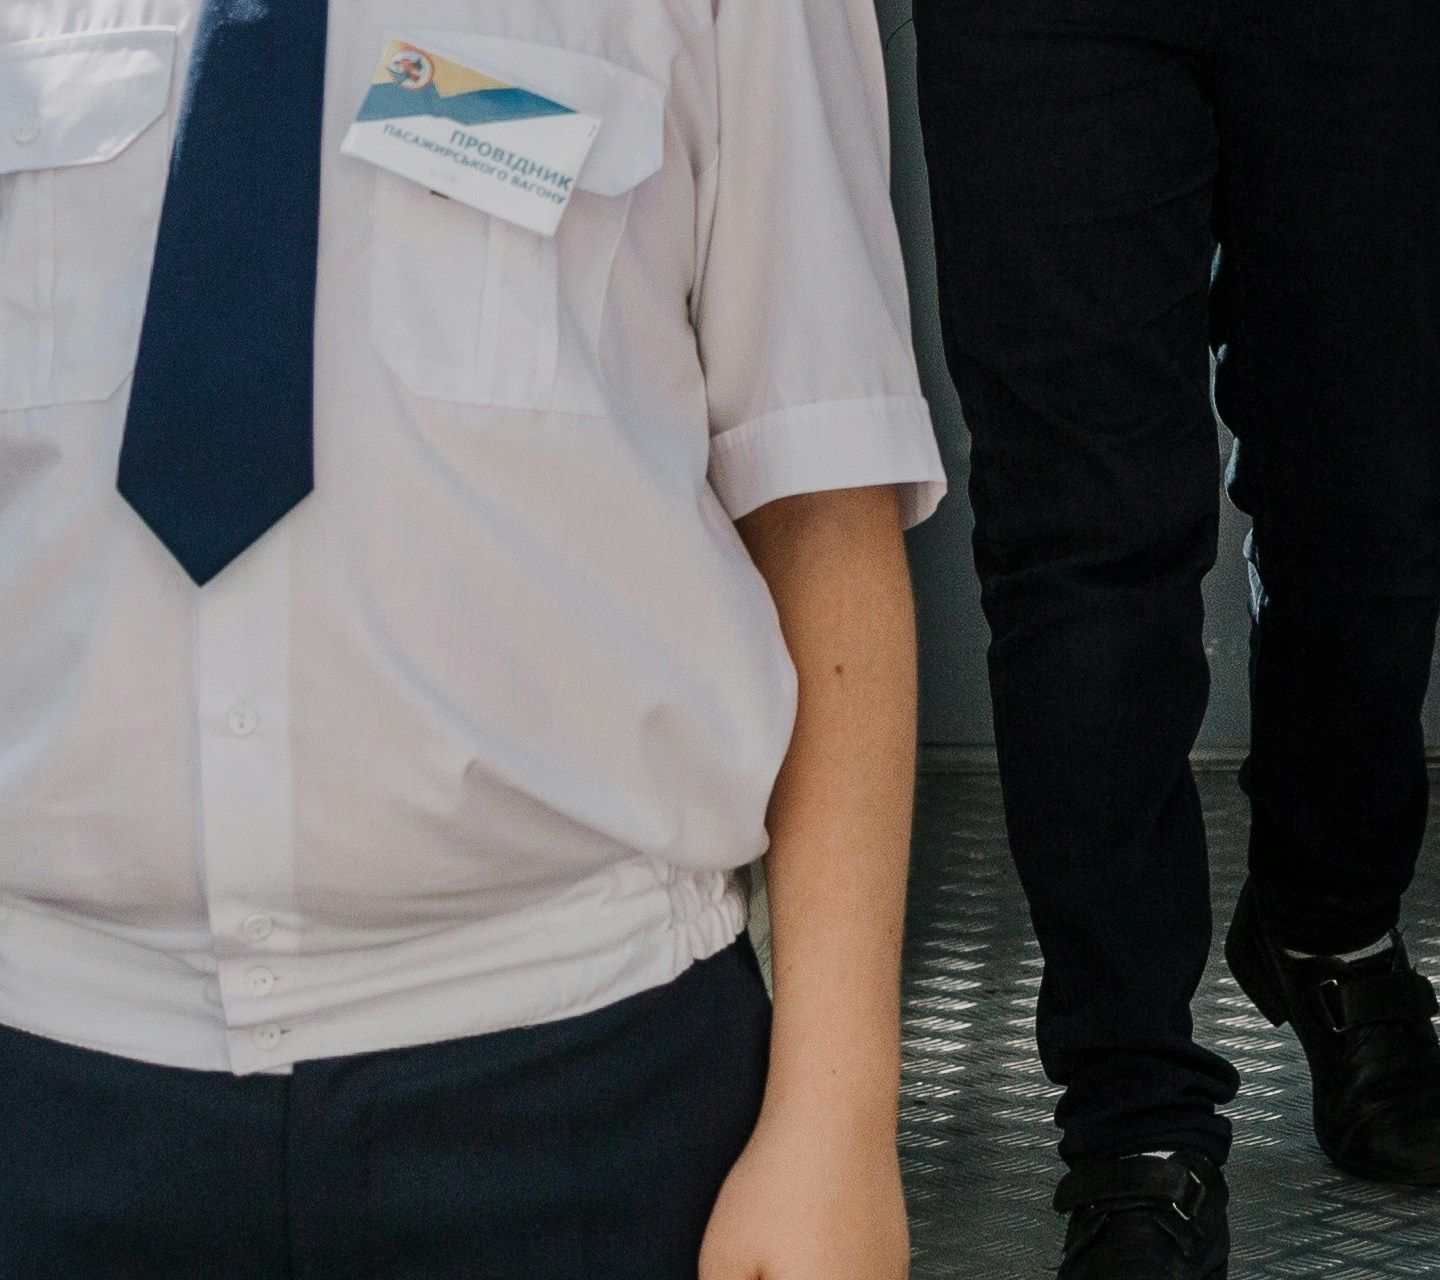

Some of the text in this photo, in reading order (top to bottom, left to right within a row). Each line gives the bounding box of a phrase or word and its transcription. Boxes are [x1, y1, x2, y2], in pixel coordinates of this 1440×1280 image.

[383, 124, 566, 205] ПАСАЖИРСЬКОГО ВАГОНУ
[450, 130, 572, 190] ПРОВІДНИК
